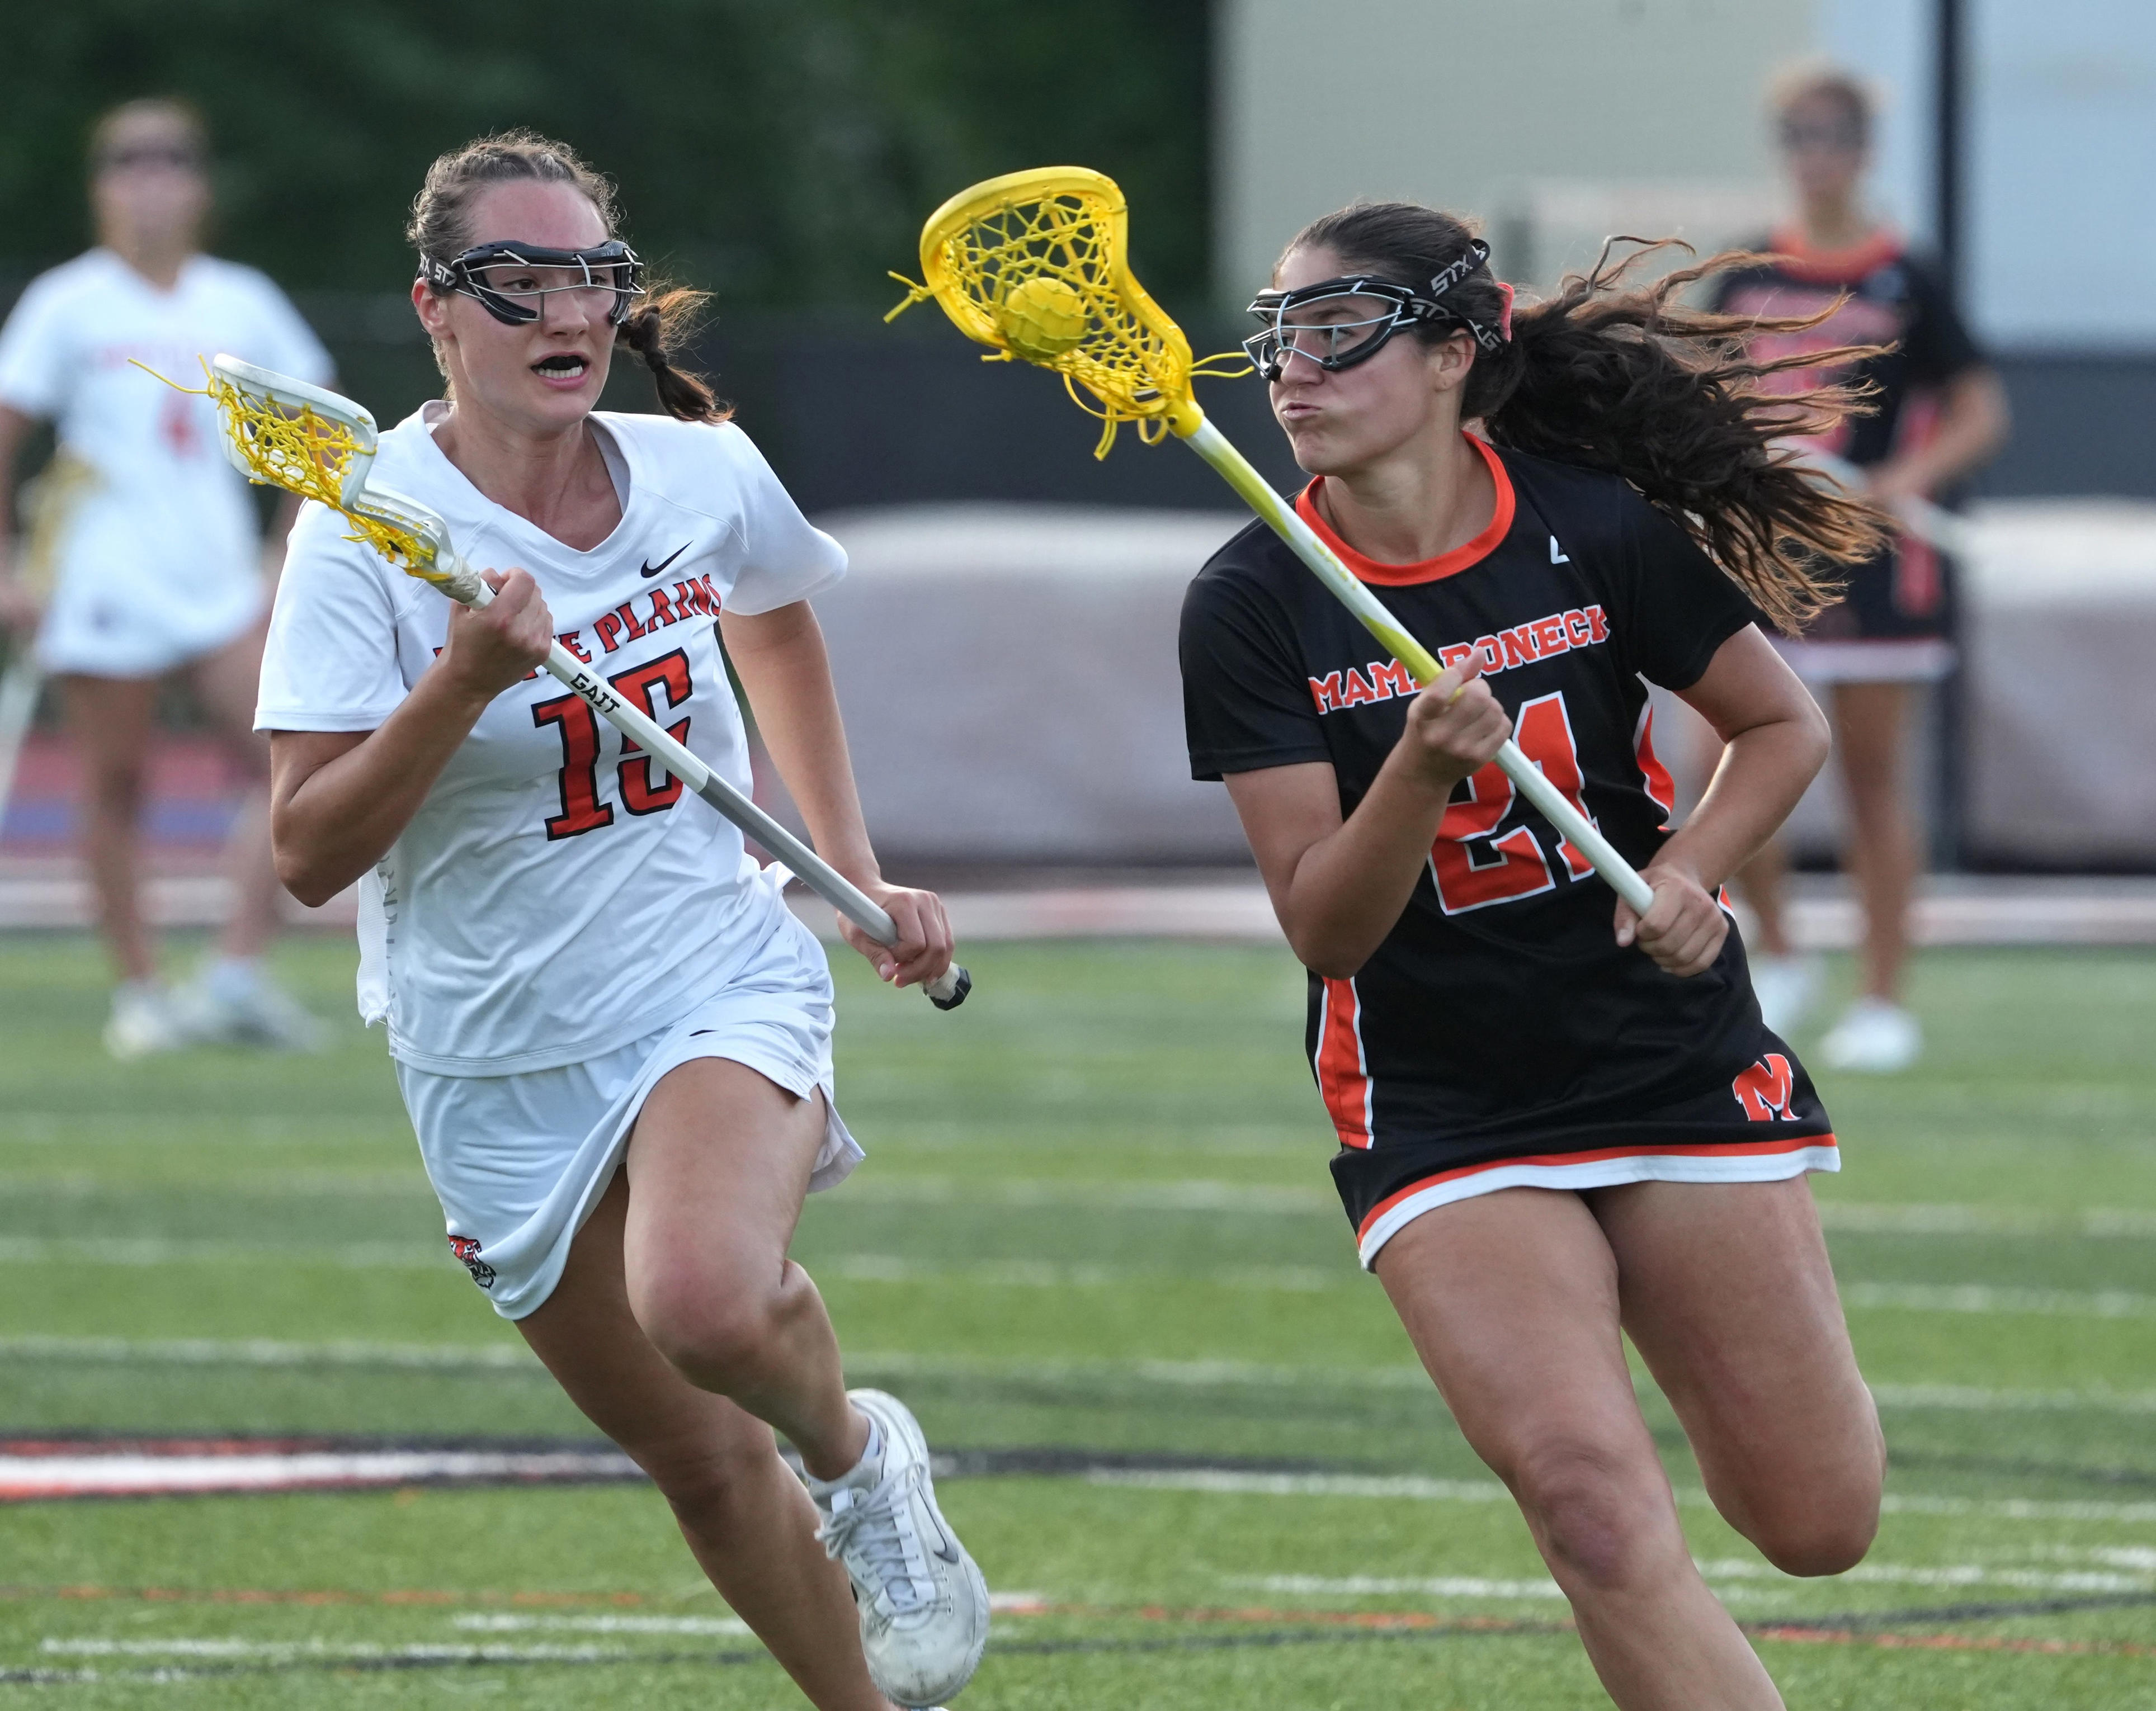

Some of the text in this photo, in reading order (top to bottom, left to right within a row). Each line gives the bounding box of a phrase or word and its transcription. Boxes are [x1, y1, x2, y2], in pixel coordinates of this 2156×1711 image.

[1430, 254, 1474, 297] STX
[593, 573, 721, 654] PLAINS
[569, 673, 621, 713] GAIT
[1308, 604, 1610, 715] MAMONECK
[531, 647, 692, 841] 15
[1427, 690, 1602, 915] 21
[1733, 1053, 1802, 1121] M
